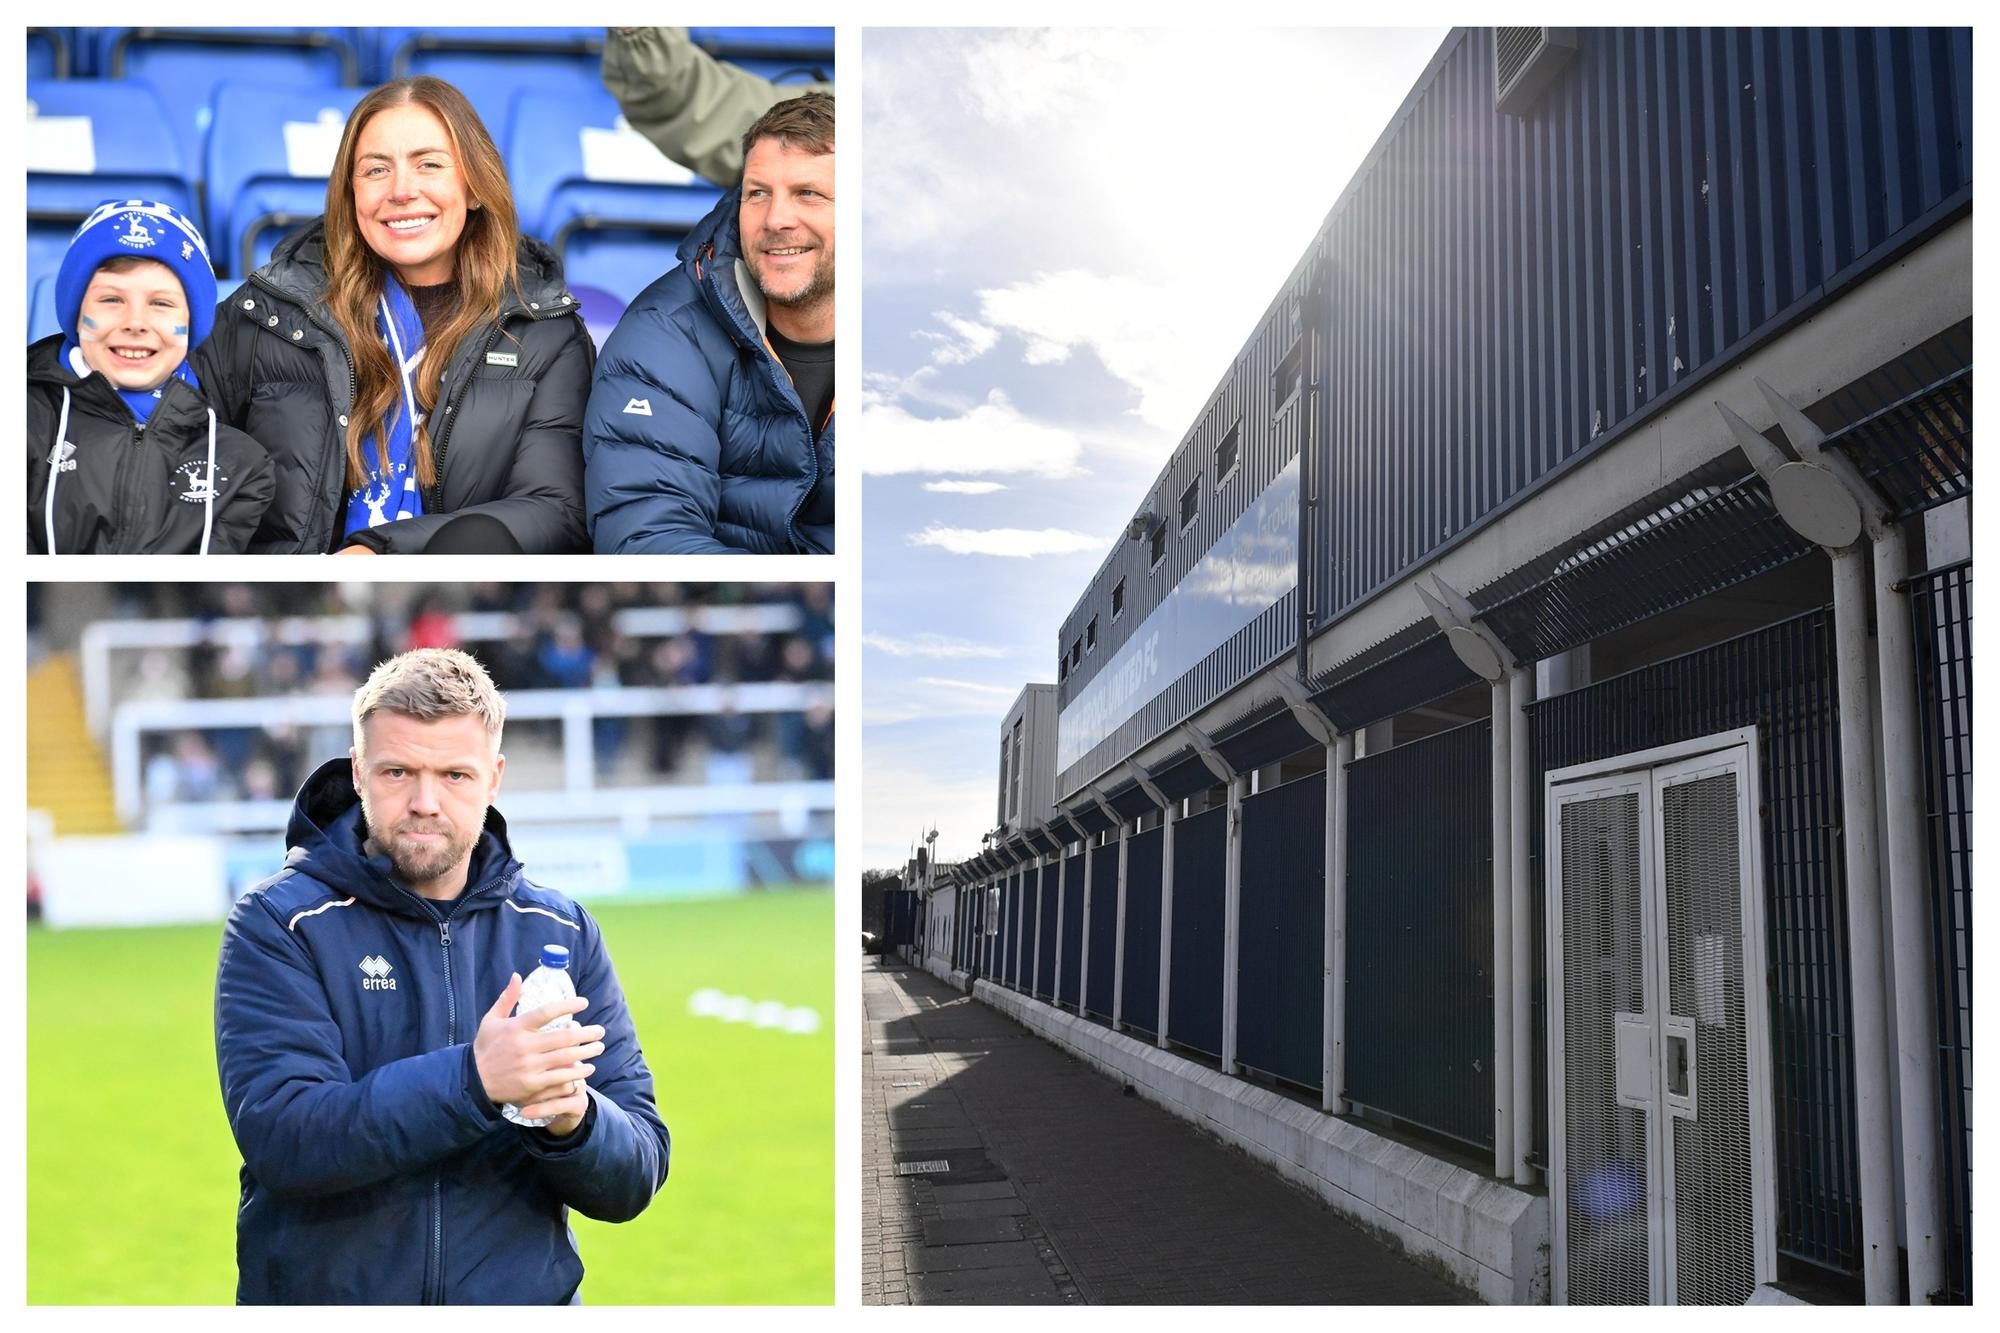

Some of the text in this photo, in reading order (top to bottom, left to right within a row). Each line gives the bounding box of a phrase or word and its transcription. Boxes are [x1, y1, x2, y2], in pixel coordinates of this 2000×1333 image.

[488, 355, 515, 363] HUNTER
[1108, 646, 1142, 716] UNITED
[1143, 629, 1159, 684] FC
